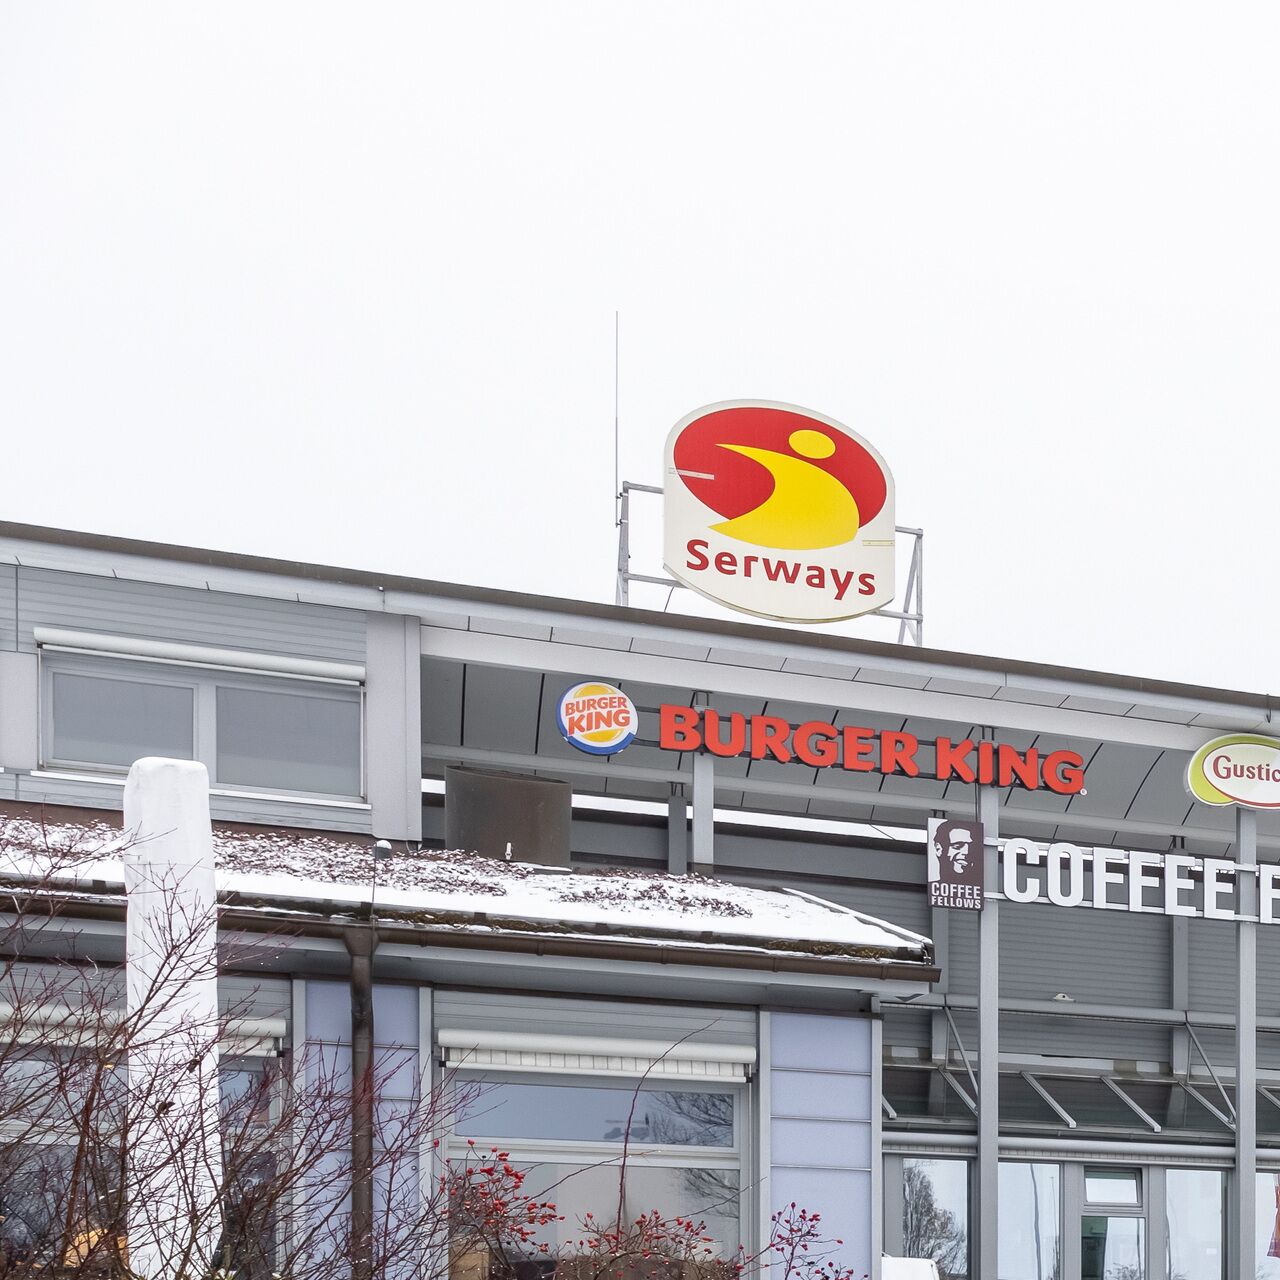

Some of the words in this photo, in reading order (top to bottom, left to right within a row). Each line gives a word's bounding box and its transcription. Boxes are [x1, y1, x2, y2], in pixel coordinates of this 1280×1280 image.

[686, 539, 876, 601] Serways
[565, 696, 628, 717] BURGER
[568, 709, 631, 736] KING
[659, 703, 920, 778] BURGER
[936, 736, 1085, 795] KING
[931, 882, 981, 899] COFFEE
[1003, 837, 1236, 920] COFFEE
[931, 896, 981, 909] FELLOWS
